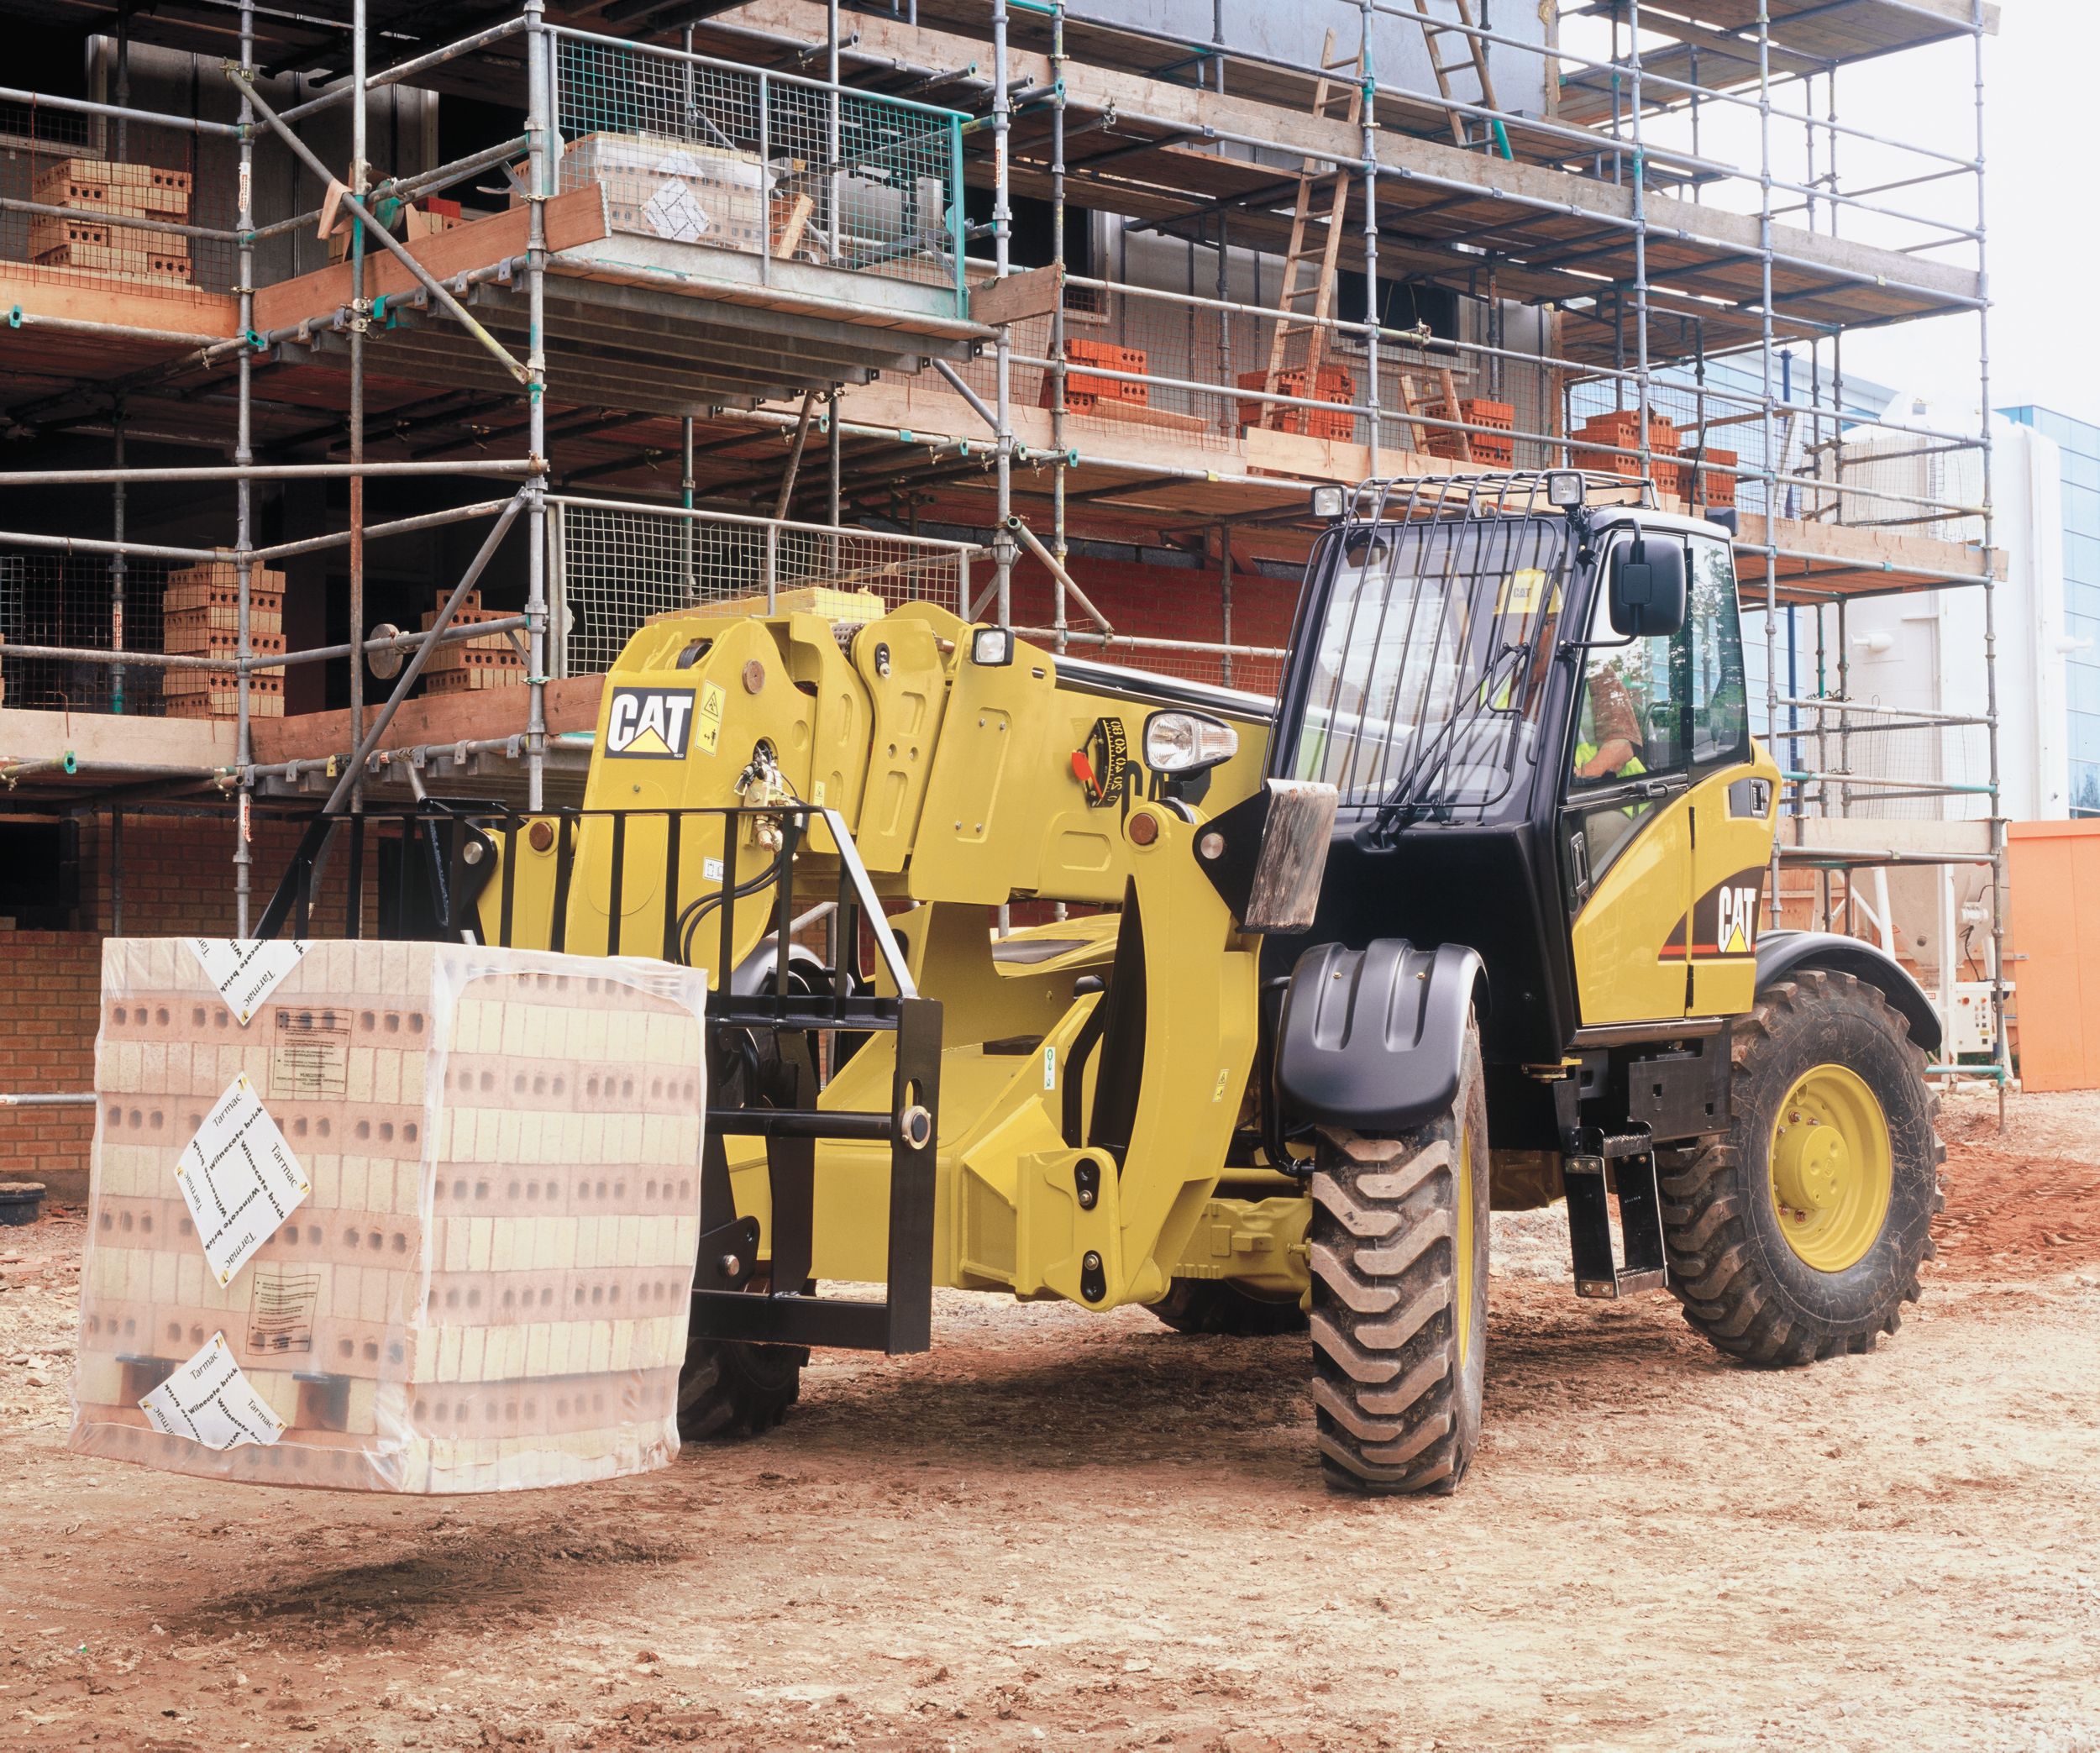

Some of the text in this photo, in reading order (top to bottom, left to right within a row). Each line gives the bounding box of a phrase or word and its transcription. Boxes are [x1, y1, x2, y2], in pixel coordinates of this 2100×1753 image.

[1513, 588, 1530, 597] CAT
[607, 694, 693, 753] CAT
[1718, 886, 1756, 953] CAT
[230, 939, 243, 958] Wil
[220, 970, 240, 993] brick
[244, 970, 276, 1007] Tarmac
[213, 1094, 242, 1127] Tarmac
[210, 1105, 264, 1170] Wilnecote brick
[193, 1139, 227, 1217] Wilnecote brick
[241, 1141, 285, 1220] Wilnecote brick
[271, 1142, 297, 1188] Tarmac
[184, 1171, 202, 1213] Tarmac
[205, 1187, 260, 1251] Wilnecote brick
[224, 1232, 257, 1269] Tarmac
[190, 1351, 218, 1379] Tarmac
[165, 1383, 181, 1407] brick
[188, 1367, 239, 1415] Wilnecote brick
[218, 1397, 249, 1432] Wilnecote
[247, 1399, 274, 1429] Tarmac
